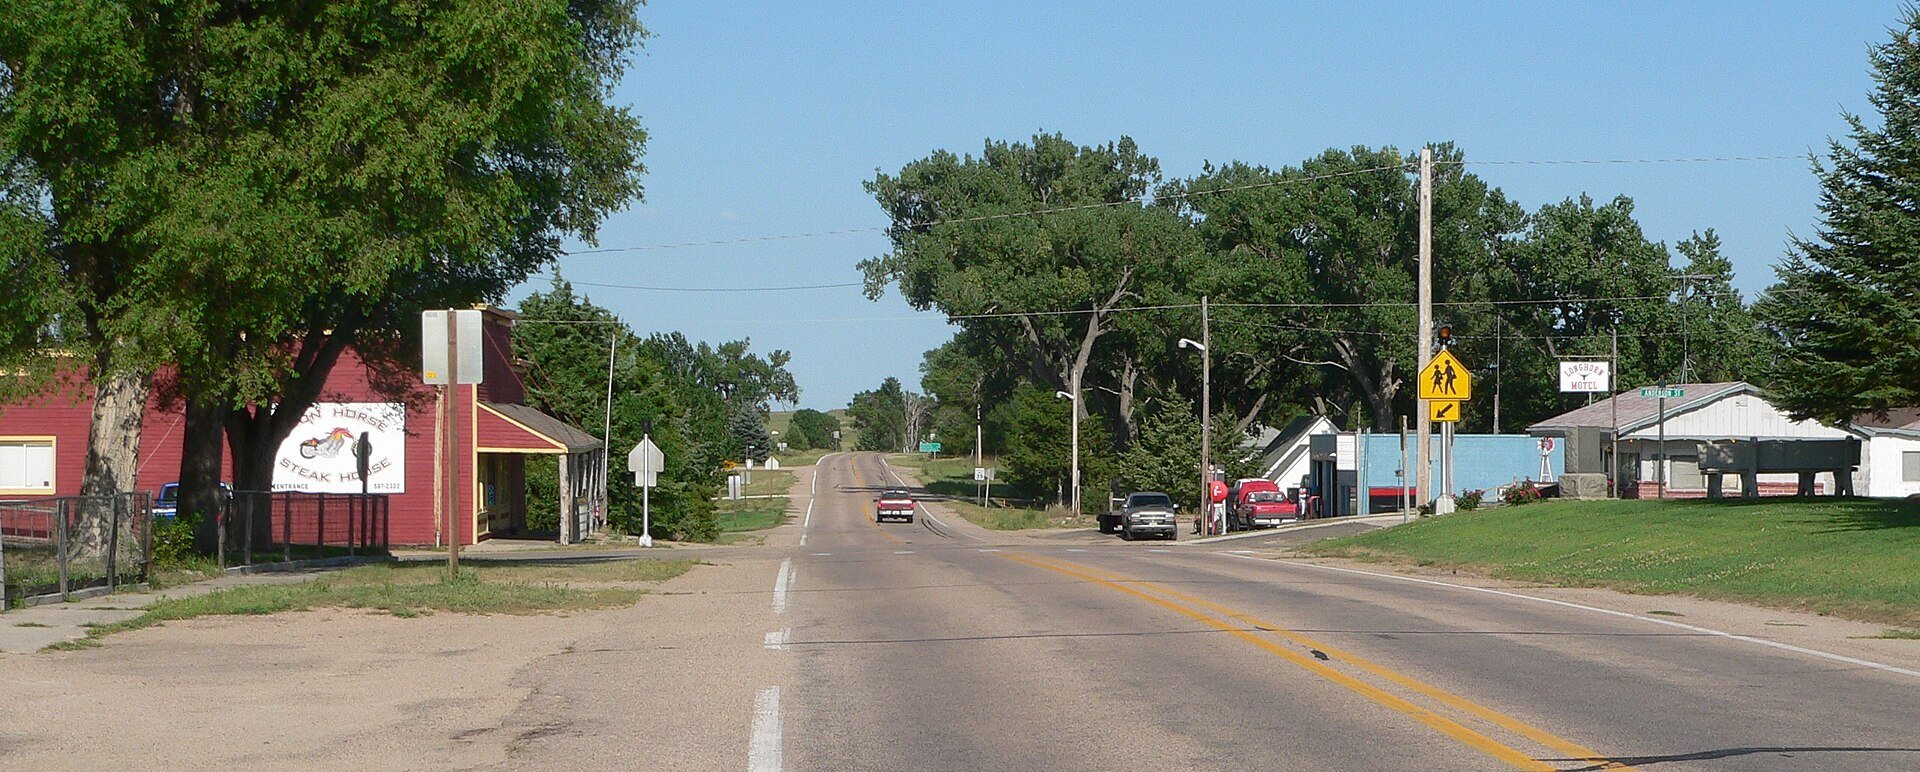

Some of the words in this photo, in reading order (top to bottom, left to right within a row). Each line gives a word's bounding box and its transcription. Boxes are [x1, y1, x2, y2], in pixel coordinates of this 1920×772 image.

[1564, 363, 1604, 377] LONGHORN
[1571, 381, 1597, 390] MOTEL
[299, 408, 321, 425] ON
[333, 408, 388, 432] HORSE
[280, 457, 333, 483] STEAK
